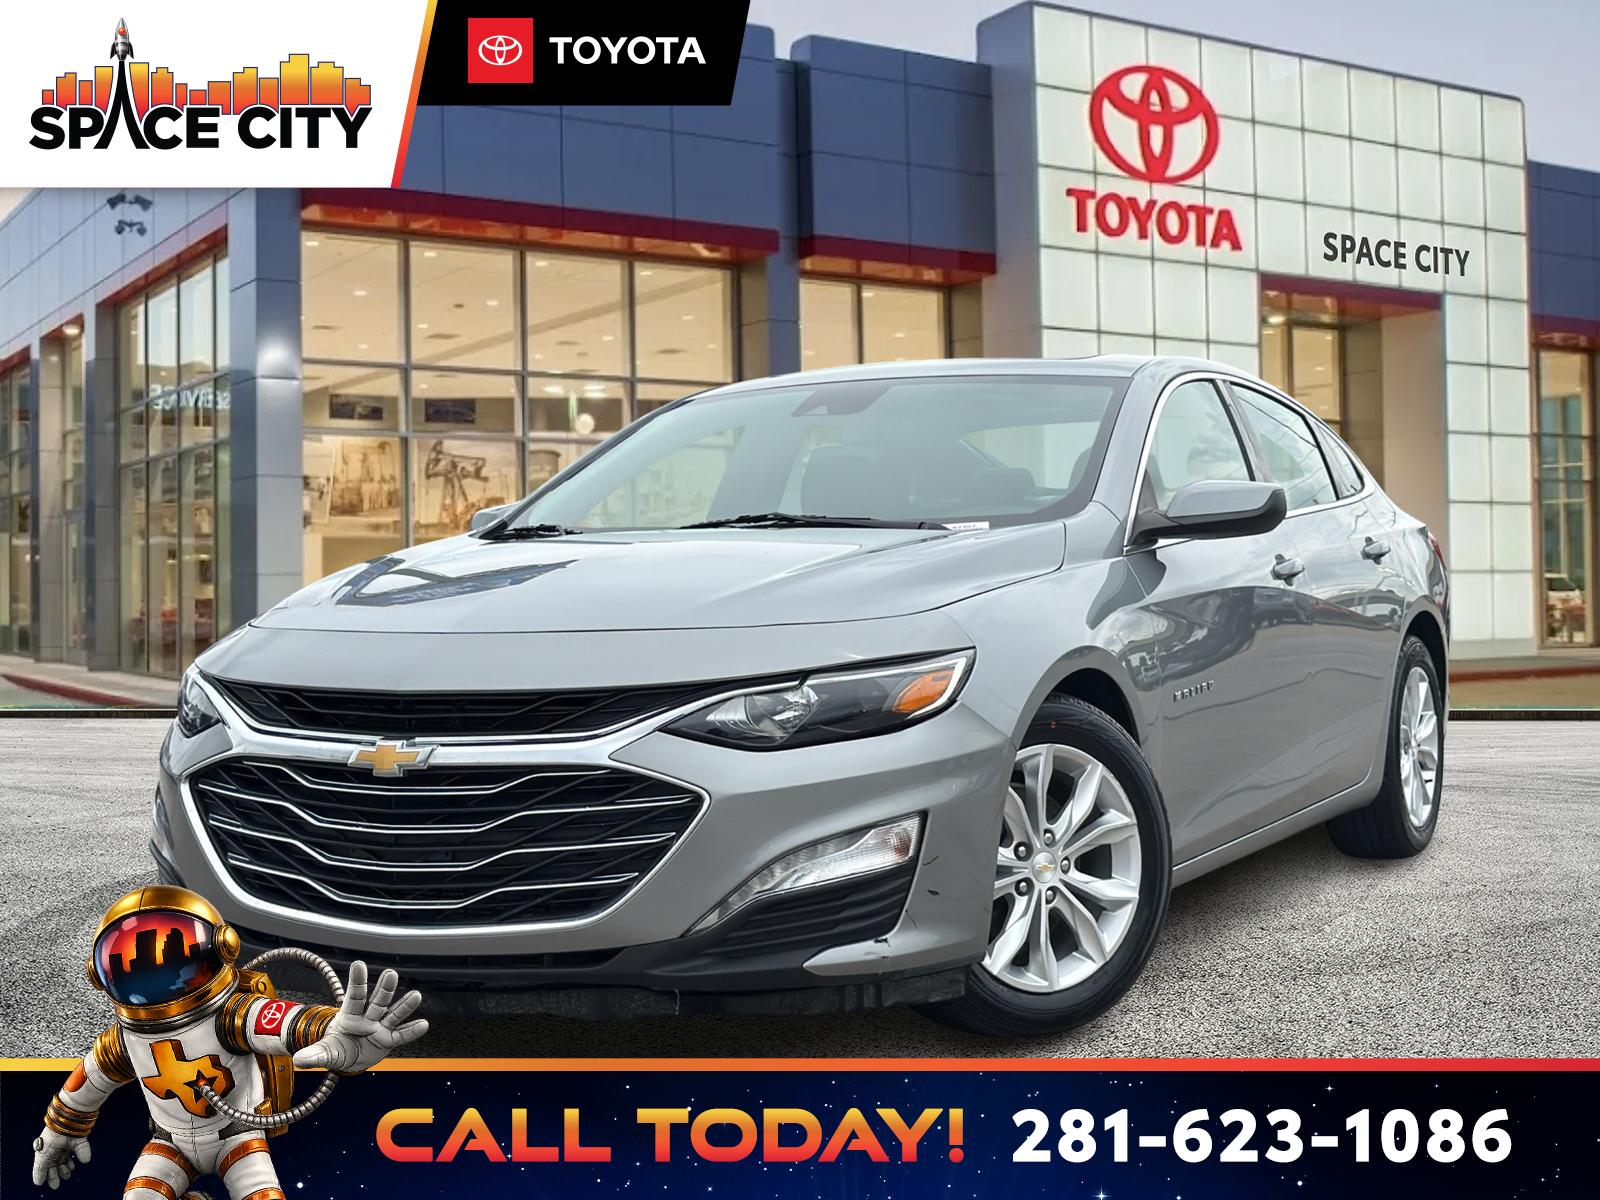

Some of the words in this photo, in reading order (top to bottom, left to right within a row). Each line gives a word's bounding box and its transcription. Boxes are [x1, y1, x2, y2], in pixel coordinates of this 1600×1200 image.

[1066, 187, 1242, 251] TOYOTA
[1322, 231, 1407, 269] SPACE
[1414, 244, 1470, 277] CITY
